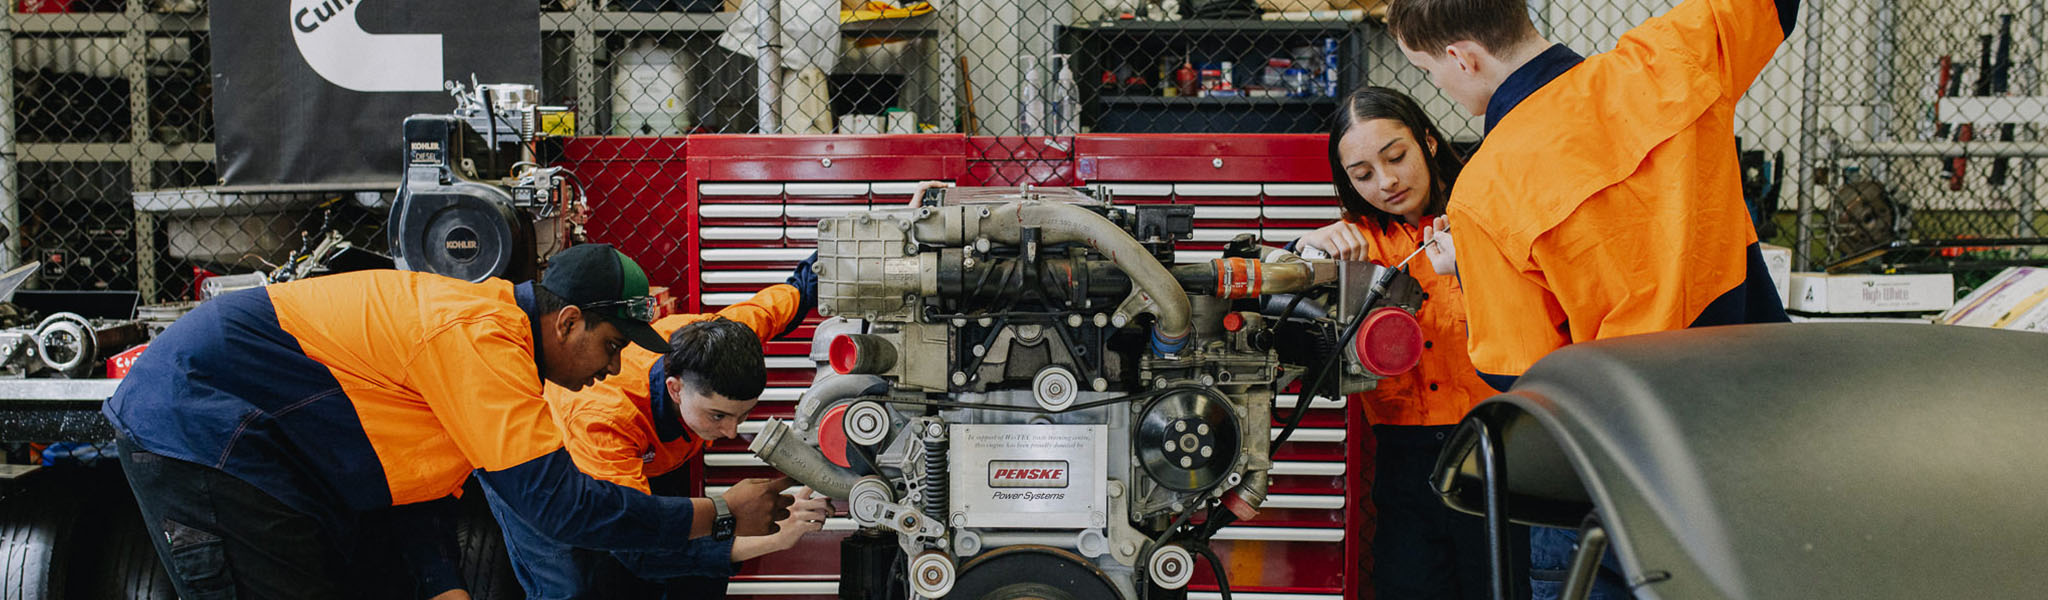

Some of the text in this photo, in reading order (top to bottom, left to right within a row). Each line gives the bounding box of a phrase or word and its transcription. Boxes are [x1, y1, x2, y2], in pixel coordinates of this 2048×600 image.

[294, 0, 353, 33] Cu
[410, 142, 440, 150] KOHLER
[446, 240, 477, 249] KOHLER
[994, 468, 1064, 480] PENSKE
[992, 491, 1065, 502] Power Systems
